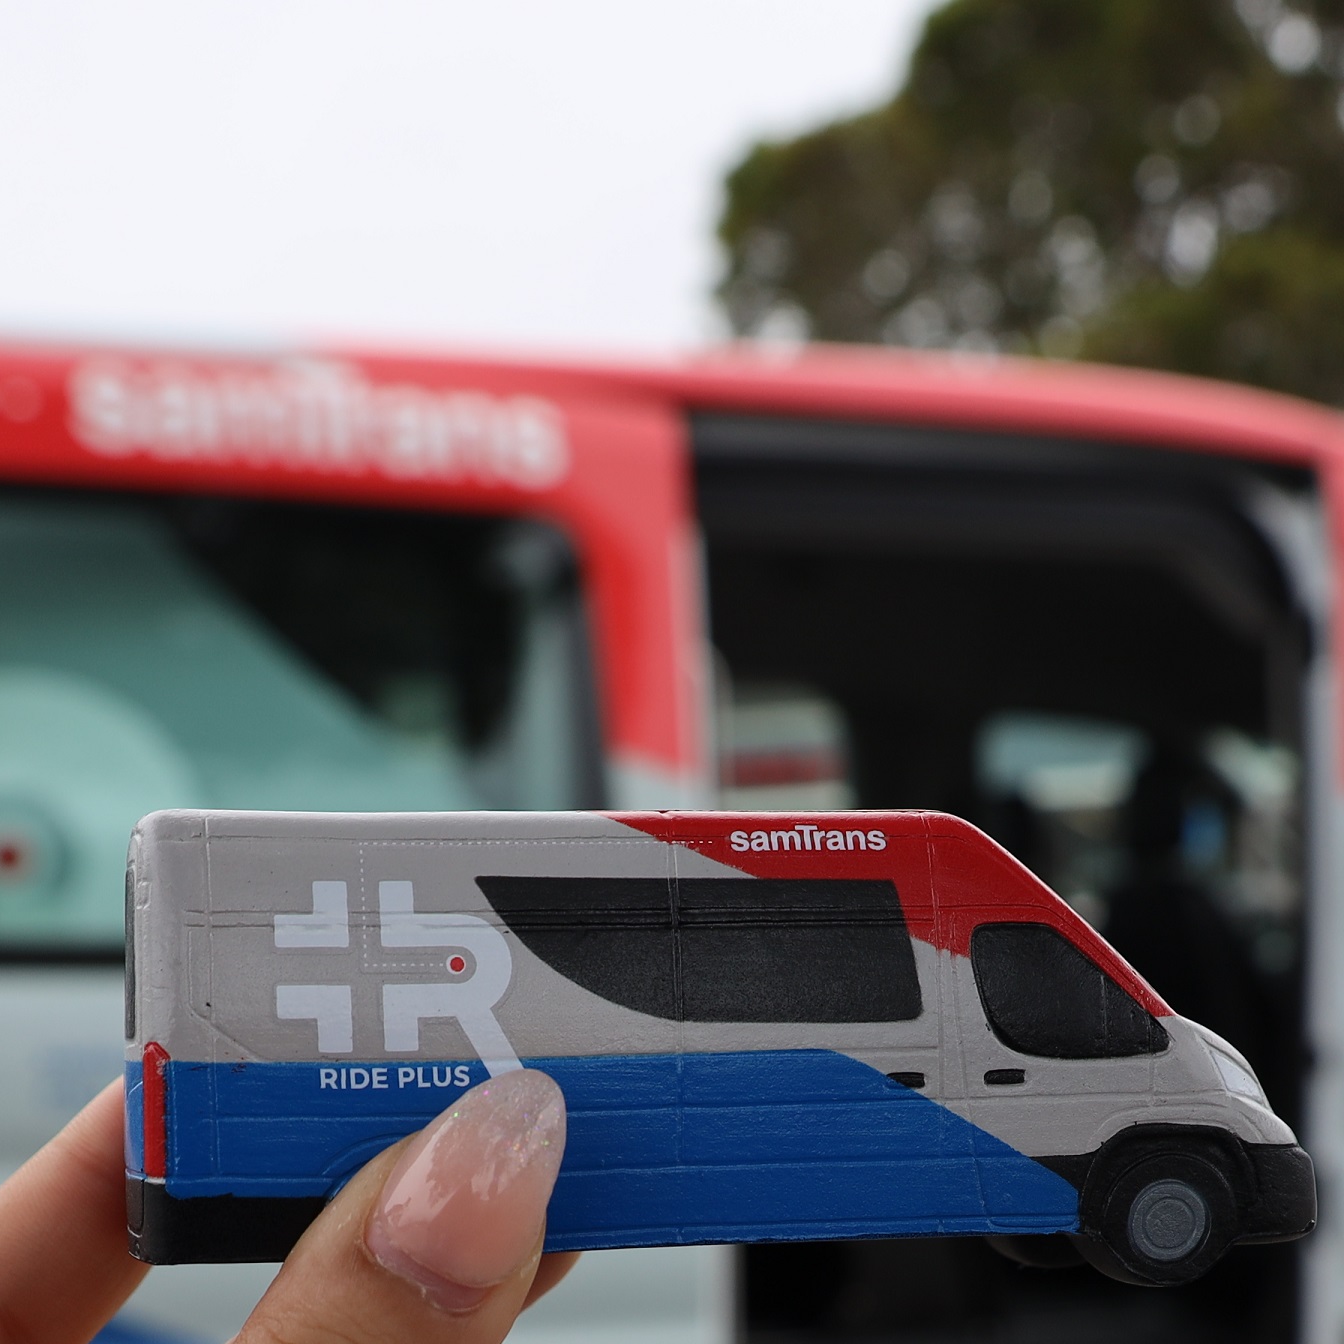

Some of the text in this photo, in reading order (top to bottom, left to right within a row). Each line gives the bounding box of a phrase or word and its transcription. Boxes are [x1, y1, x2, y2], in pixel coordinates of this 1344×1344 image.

[67, 354, 569, 491] samTrans
[730, 824, 888, 852] samTrans
[320, 1066, 471, 1090] RIDE PLUS
